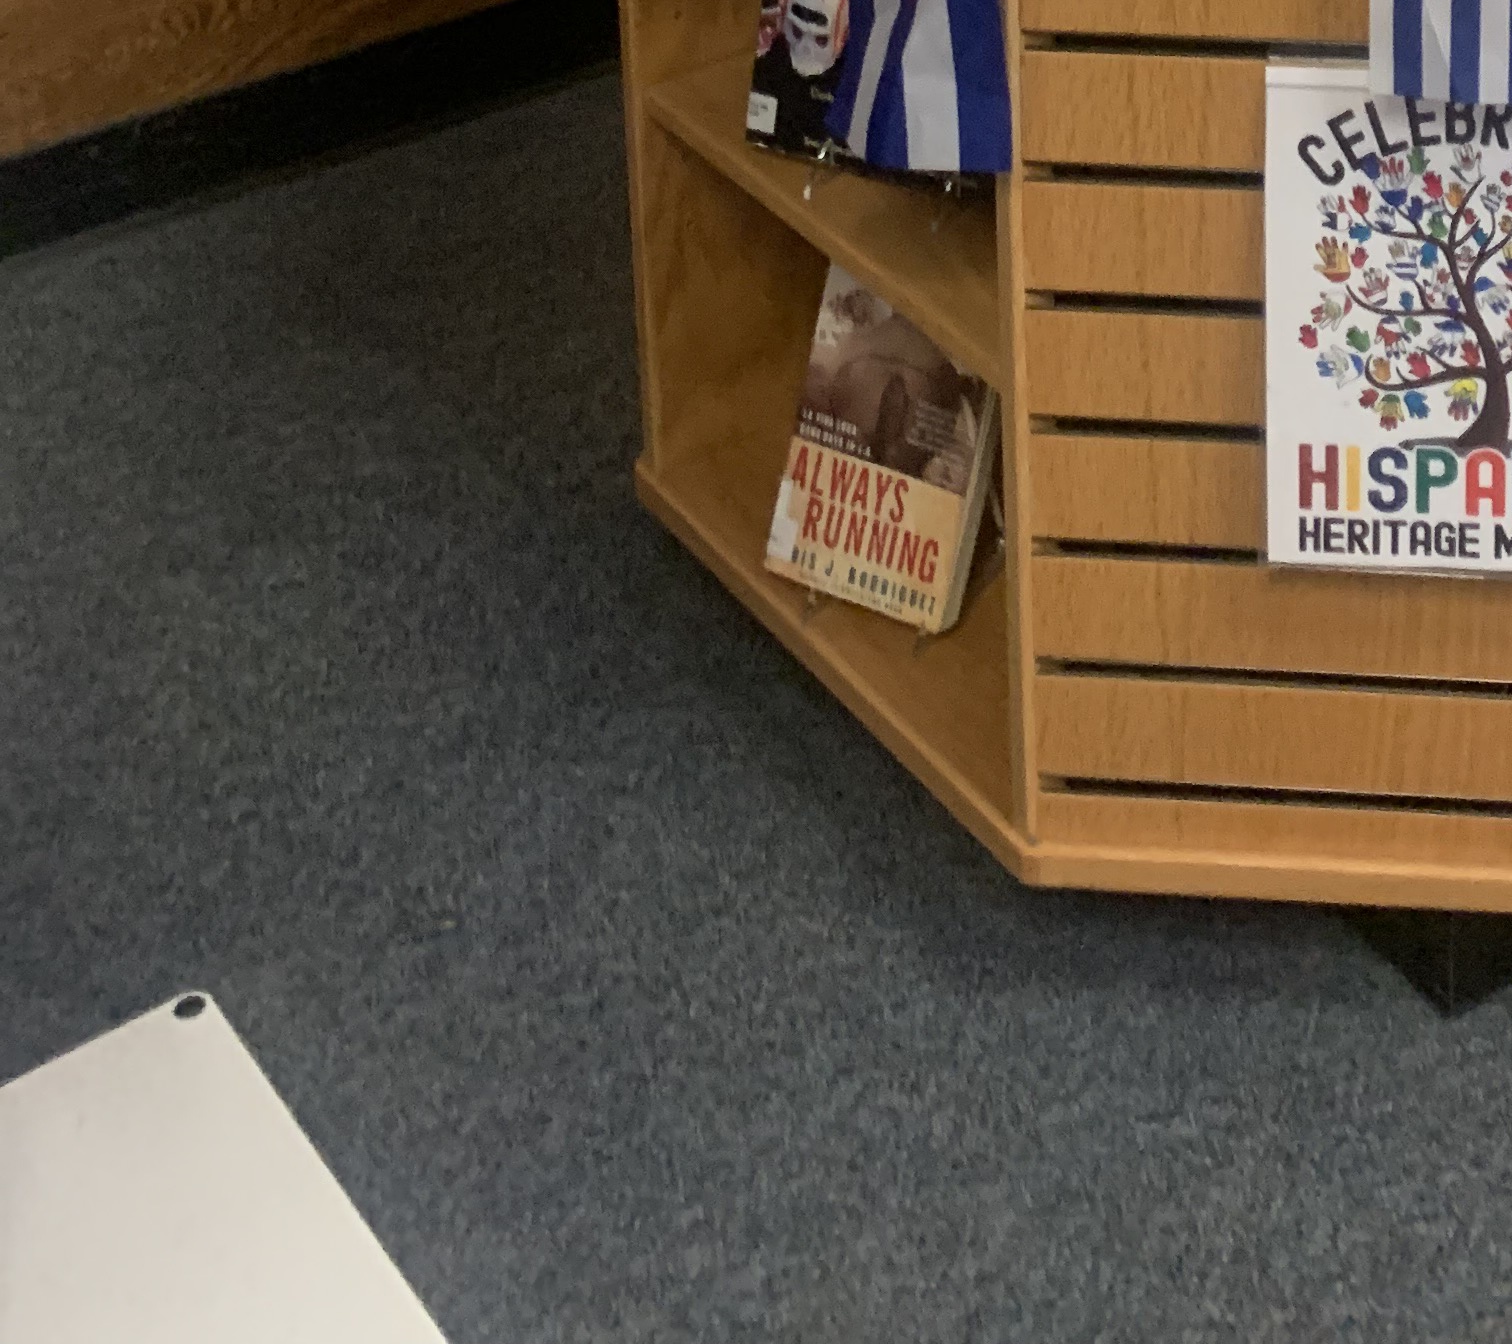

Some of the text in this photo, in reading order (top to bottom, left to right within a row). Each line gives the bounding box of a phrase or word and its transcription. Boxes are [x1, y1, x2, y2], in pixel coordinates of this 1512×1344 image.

[792, 445, 909, 523] ALWAYS
[802, 496, 939, 584] RUNNING
[1299, 516, 1482, 560] HERITAGE
